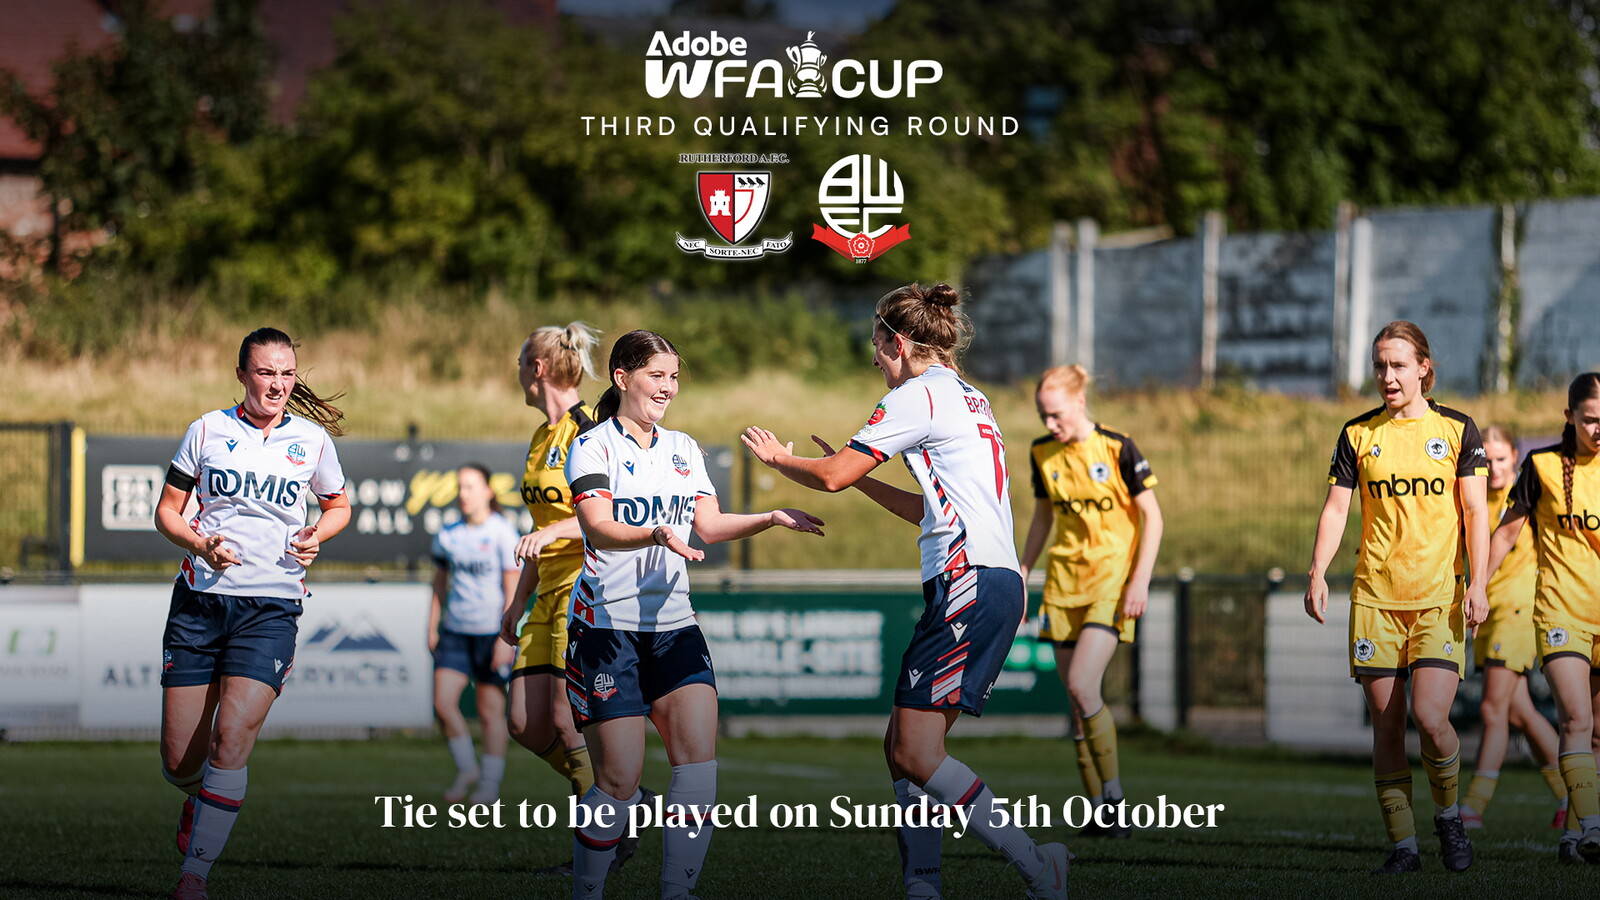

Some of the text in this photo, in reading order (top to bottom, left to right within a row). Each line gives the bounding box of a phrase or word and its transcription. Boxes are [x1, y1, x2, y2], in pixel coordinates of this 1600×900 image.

[208, 468, 301, 507] DOMIS
[520, 481, 564, 505] bna
[1367, 473, 1445, 499] mbna
